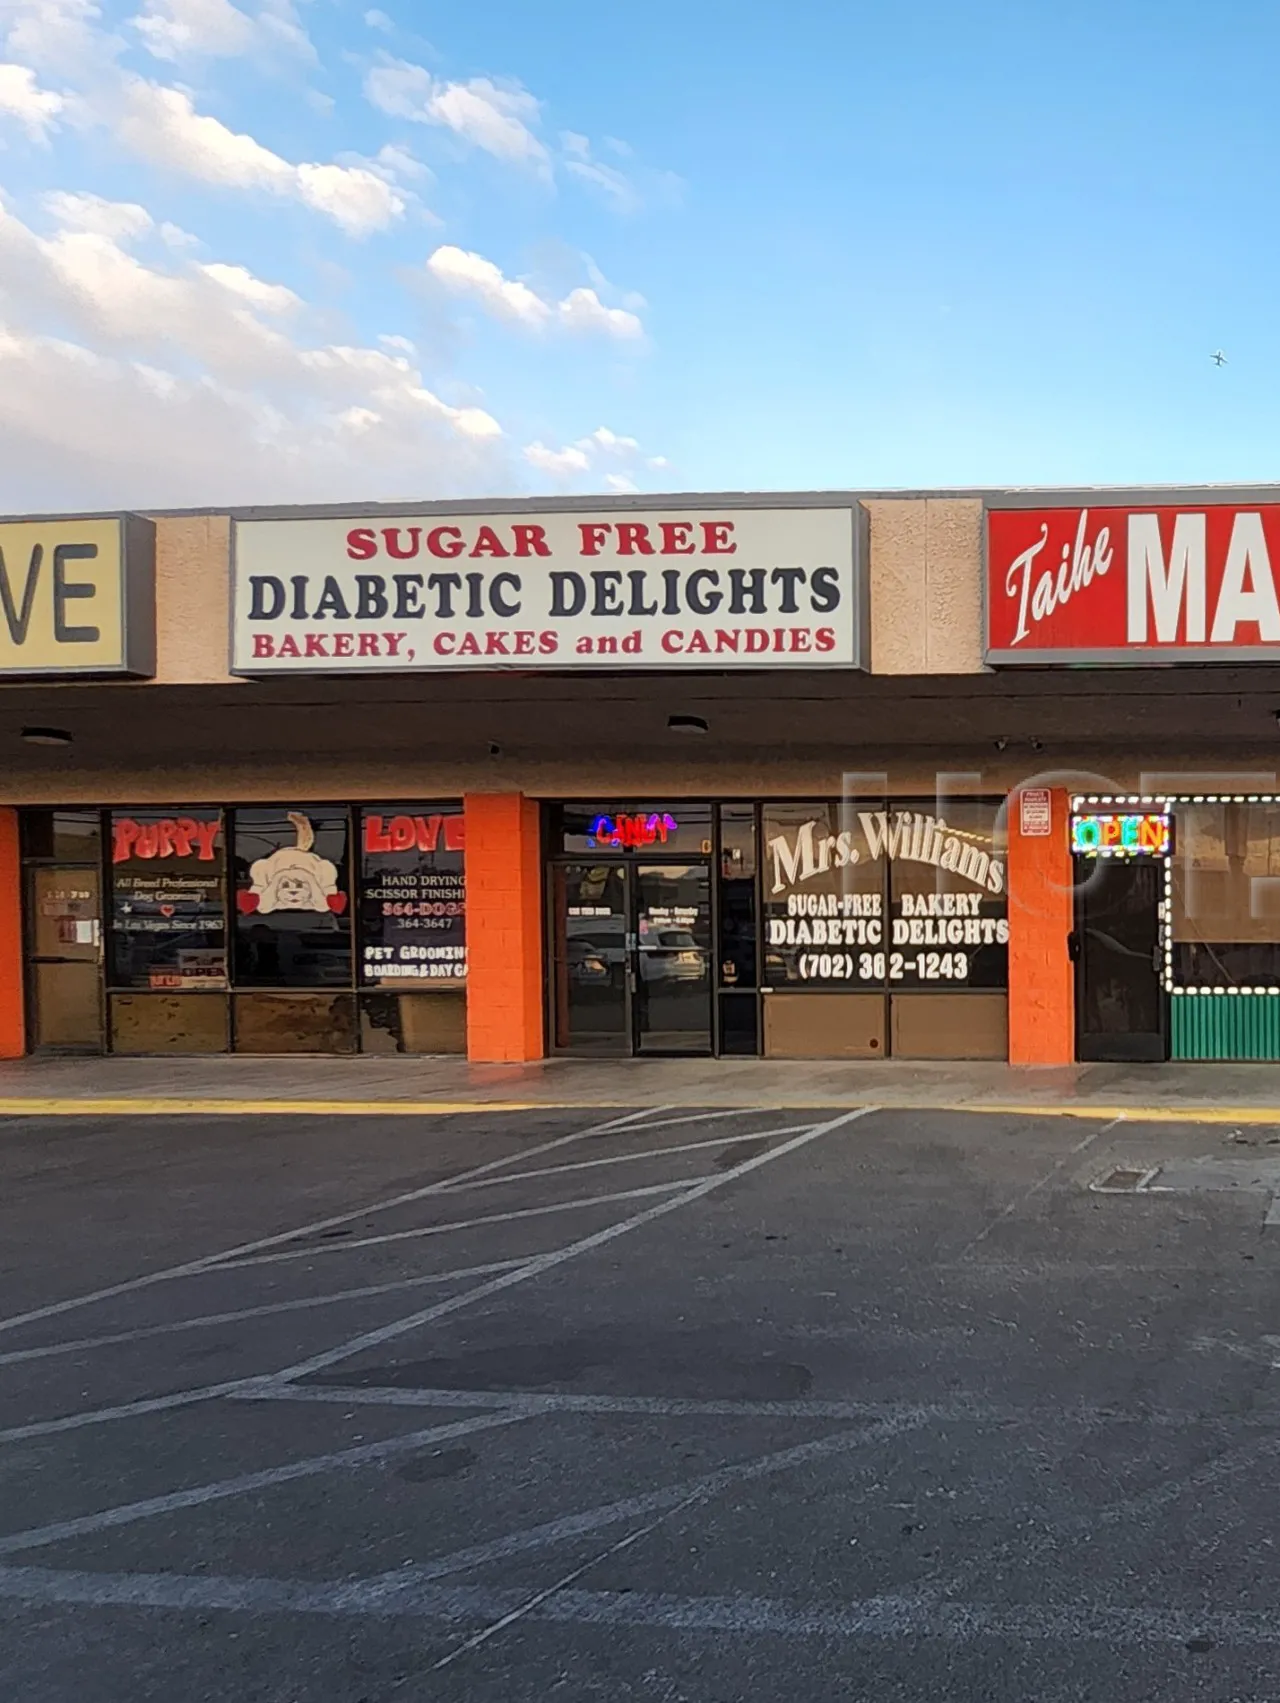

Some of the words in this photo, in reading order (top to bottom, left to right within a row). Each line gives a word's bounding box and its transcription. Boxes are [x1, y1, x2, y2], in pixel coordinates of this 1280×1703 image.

[346, 524, 552, 560] SUGAR
[577, 521, 738, 556] FREE
[0, 543, 100, 645] VE
[247, 571, 522, 620] DIABETIC
[548, 566, 841, 617] DELIGHTS
[1006, 508, 1114, 647] Taihe
[252, 631, 416, 662] BAKERY,
[432, 630, 559, 656] CAKES
[575, 630, 644, 655] and
[661, 628, 837, 654] CANDIES
[112, 817, 222, 864] PUPPY
[365, 815, 465, 852] LOVE
[596, 812, 669, 847] CANDY
[1076, 815, 1164, 850] OPEN
[768, 821, 861, 895] Mrs.
[857, 810, 1005, 895] Williams
[366, 889, 418, 899] SCISSOR
[382, 875, 417, 886] HAND
[788, 893, 882, 917] SUGAR-FREE
[901, 893, 983, 917] BAKERY
[397, 918, 453, 929] 364-3647
[769, 919, 882, 945] DIABETIC
[892, 919, 1010, 945] DELIGHTS
[364, 946, 394, 960] PET
[799, 953, 853, 979] (702)
